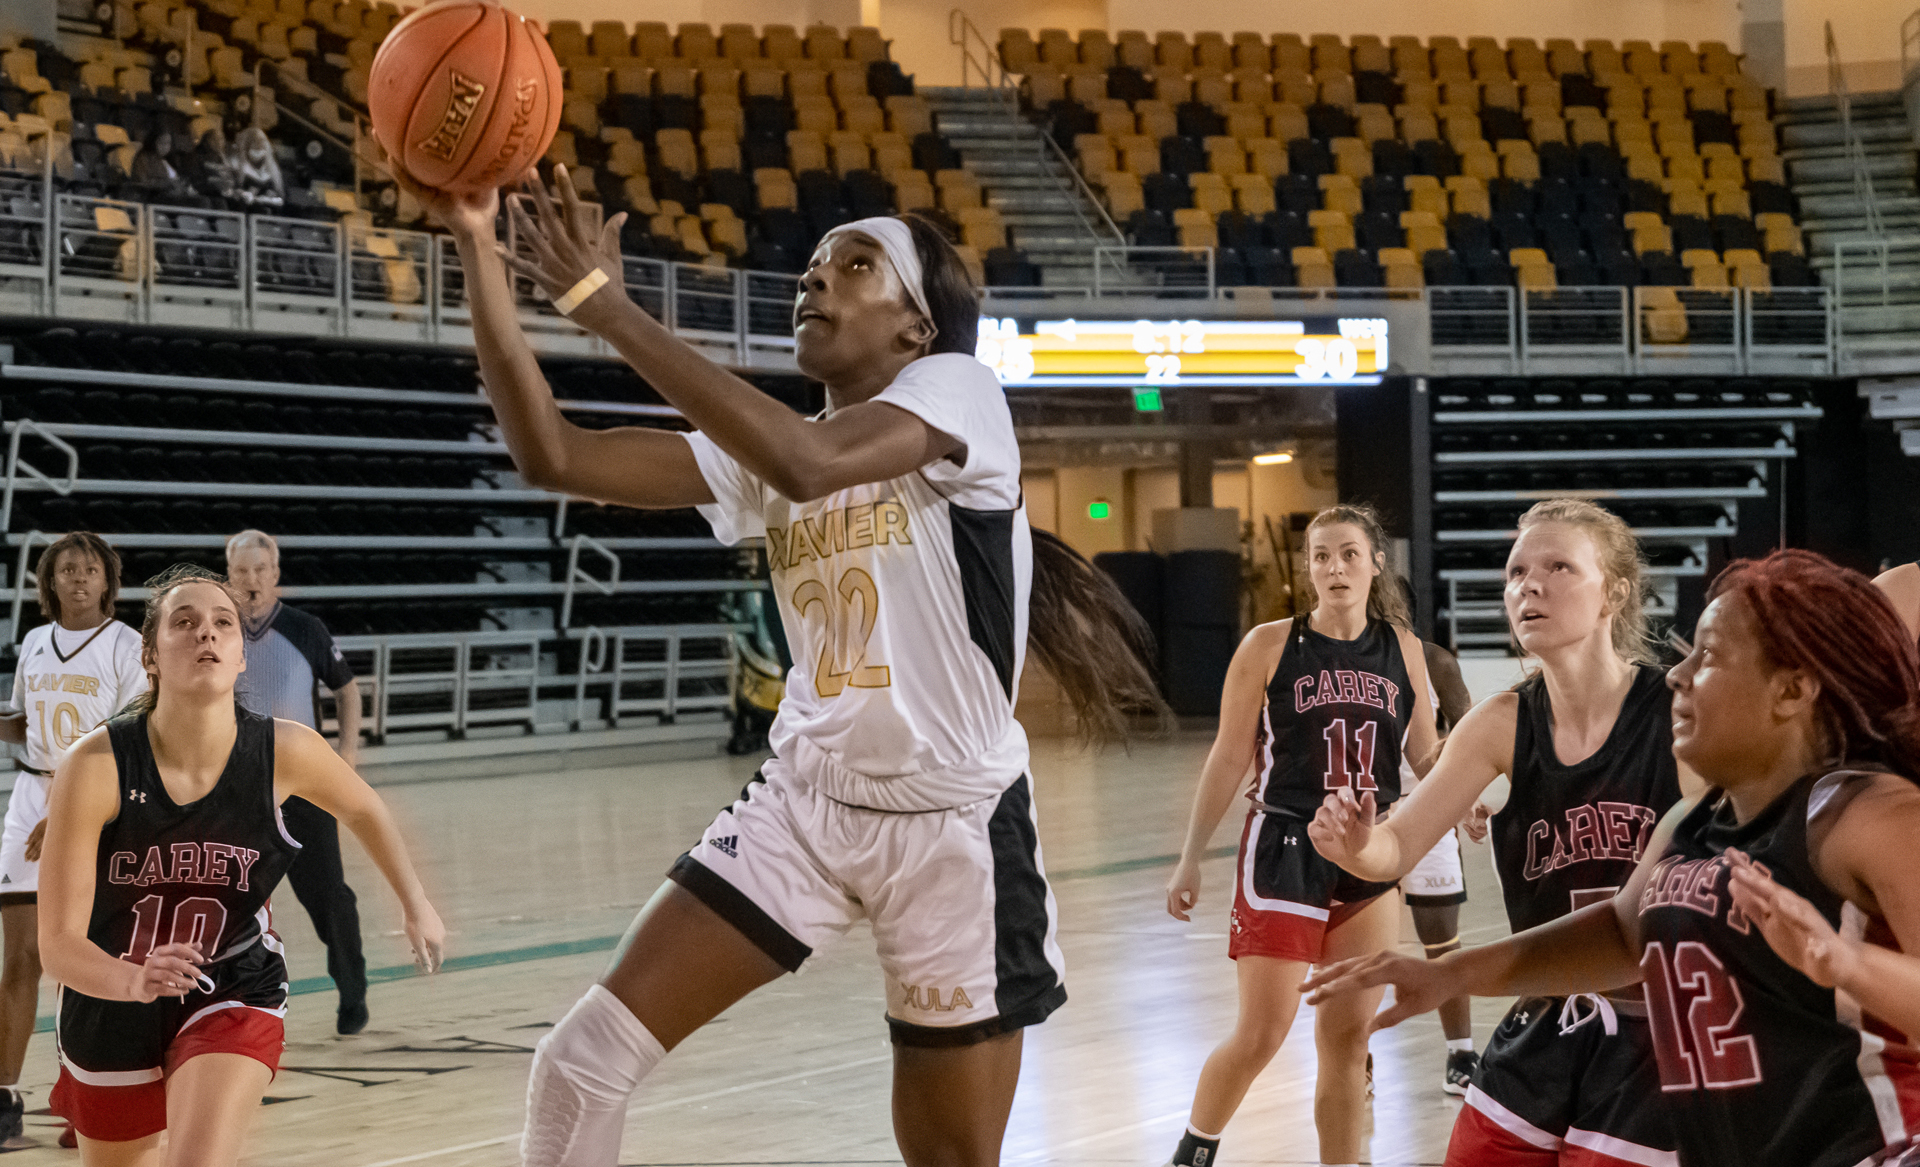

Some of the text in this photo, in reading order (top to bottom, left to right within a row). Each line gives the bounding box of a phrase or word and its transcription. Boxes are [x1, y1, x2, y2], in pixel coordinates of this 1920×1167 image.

[418, 70, 485, 161] NAIA
[467, 78, 538, 184] SPALD
[1144, 354, 1181, 385] 22
[1294, 339, 1357, 381] 30
[766, 501, 913, 571] XAVIER
[792, 567, 891, 698] 22
[27, 673, 100, 697] XAVIER
[1294, 669, 1399, 718] CAREY
[36, 700, 80, 754] 10
[1323, 718, 1379, 791] 11
[108, 842, 260, 892] CAREY
[709, 838, 738, 858] adidas
[119, 893, 228, 967] 10
[901, 982, 973, 1011] XULA
[1639, 941, 1762, 1092] 12
